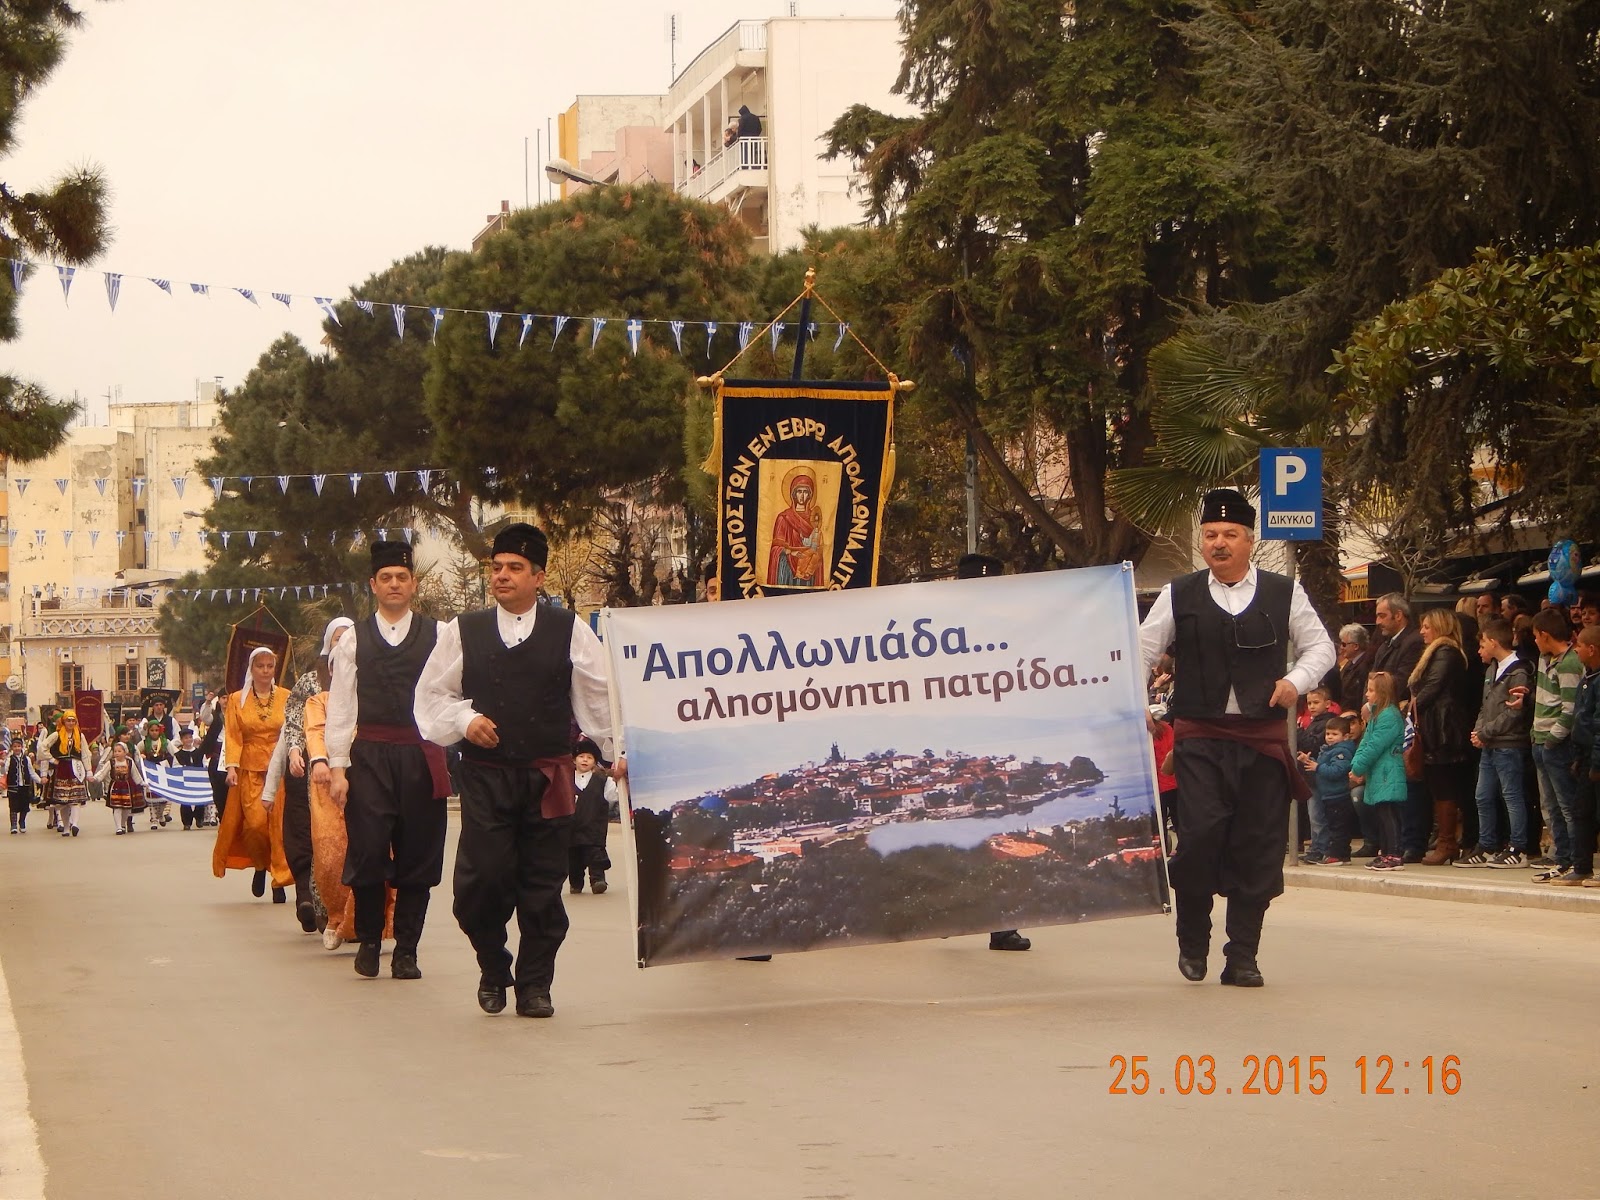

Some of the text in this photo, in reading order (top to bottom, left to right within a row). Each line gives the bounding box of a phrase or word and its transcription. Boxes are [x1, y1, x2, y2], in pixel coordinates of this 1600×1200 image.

[726, 455, 756, 500] ΤΩΝ
[747, 425, 777, 458] ΕΝ
[776, 417, 826, 442] ΕΒΡΩ
[1275, 455, 1307, 496] P
[1269, 515, 1313, 525] ΔΙΚΥΚΛΟ
[623, 618, 1008, 681] "Απολλωνιάδα...
[677, 650, 1121, 722] αλησμόνητη πατρίδα..."
